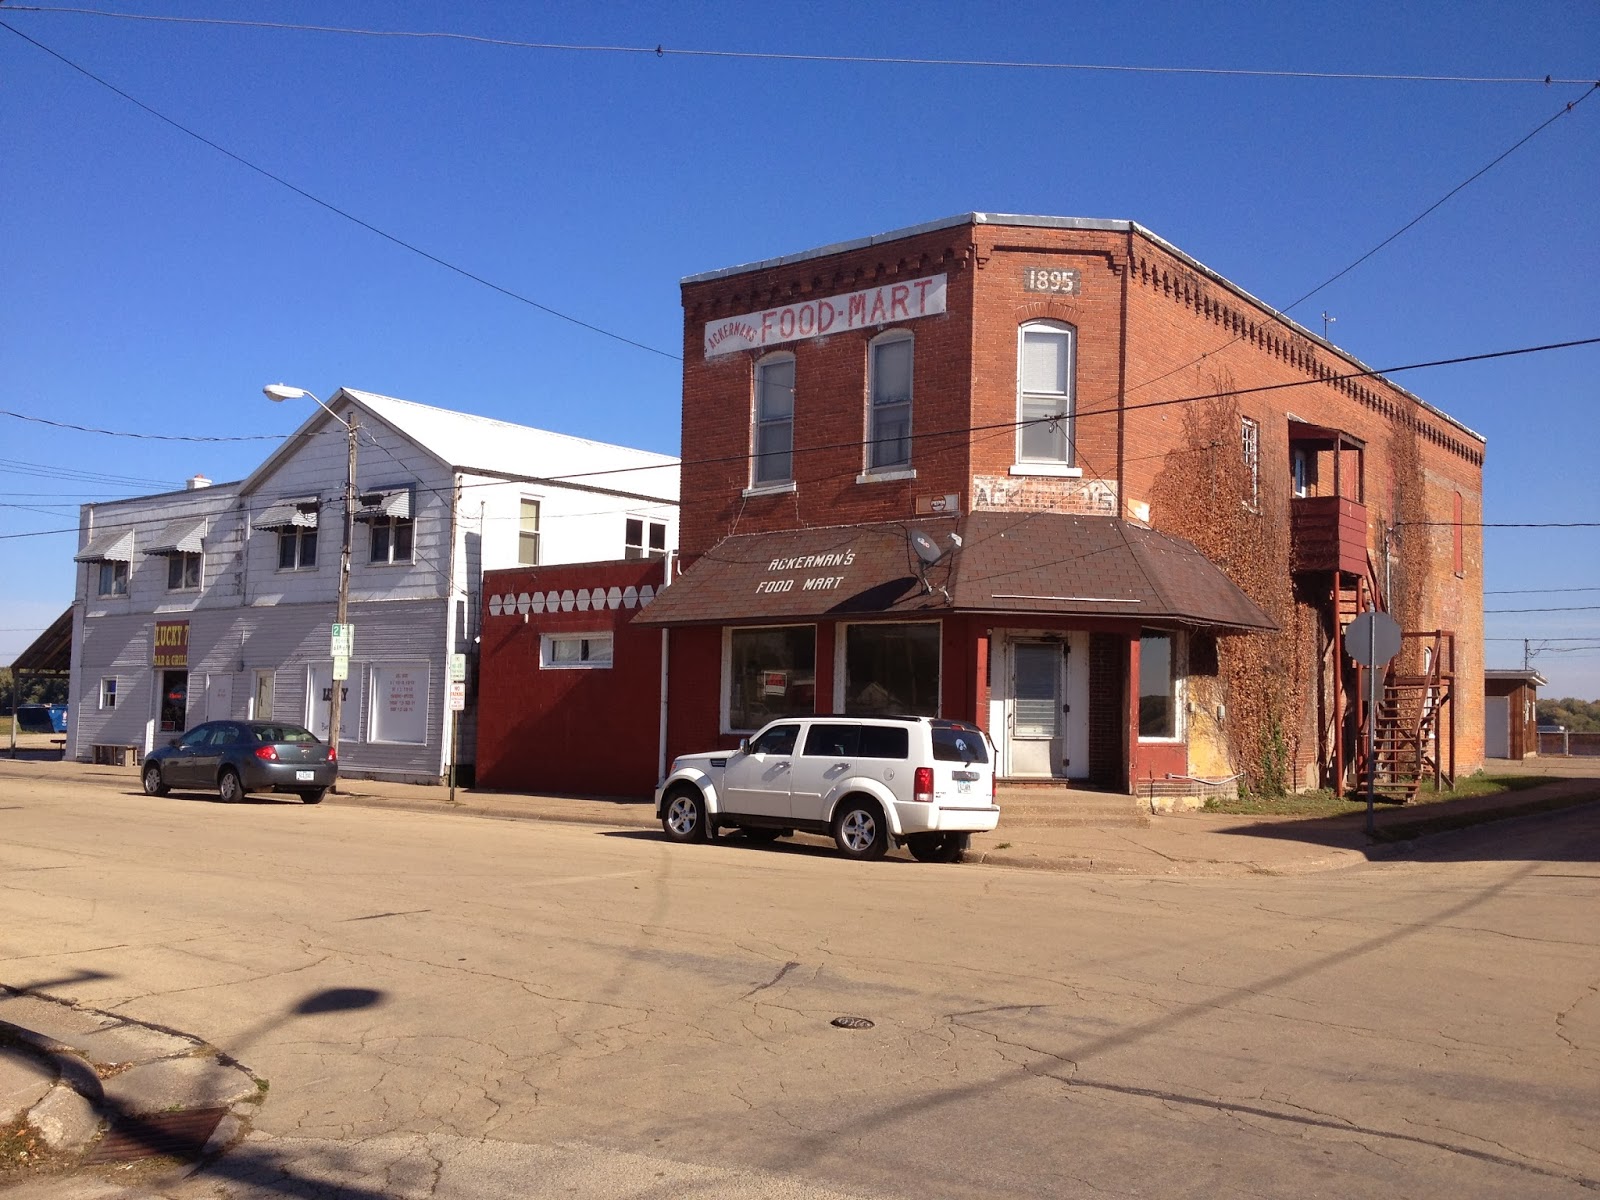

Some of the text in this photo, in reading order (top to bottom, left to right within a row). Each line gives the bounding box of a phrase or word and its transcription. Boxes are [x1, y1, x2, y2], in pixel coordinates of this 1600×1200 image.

[1029, 270, 1074, 291] 1895
[767, 548, 856, 571] ACKERMAN'S
[755, 576, 844, 594] FOOD MART
[154, 625, 191, 647] LUCKY 7
[333, 626, 340, 636] 2
[153, 655, 165, 666] BAR
[171, 654, 188, 666] GRILL
